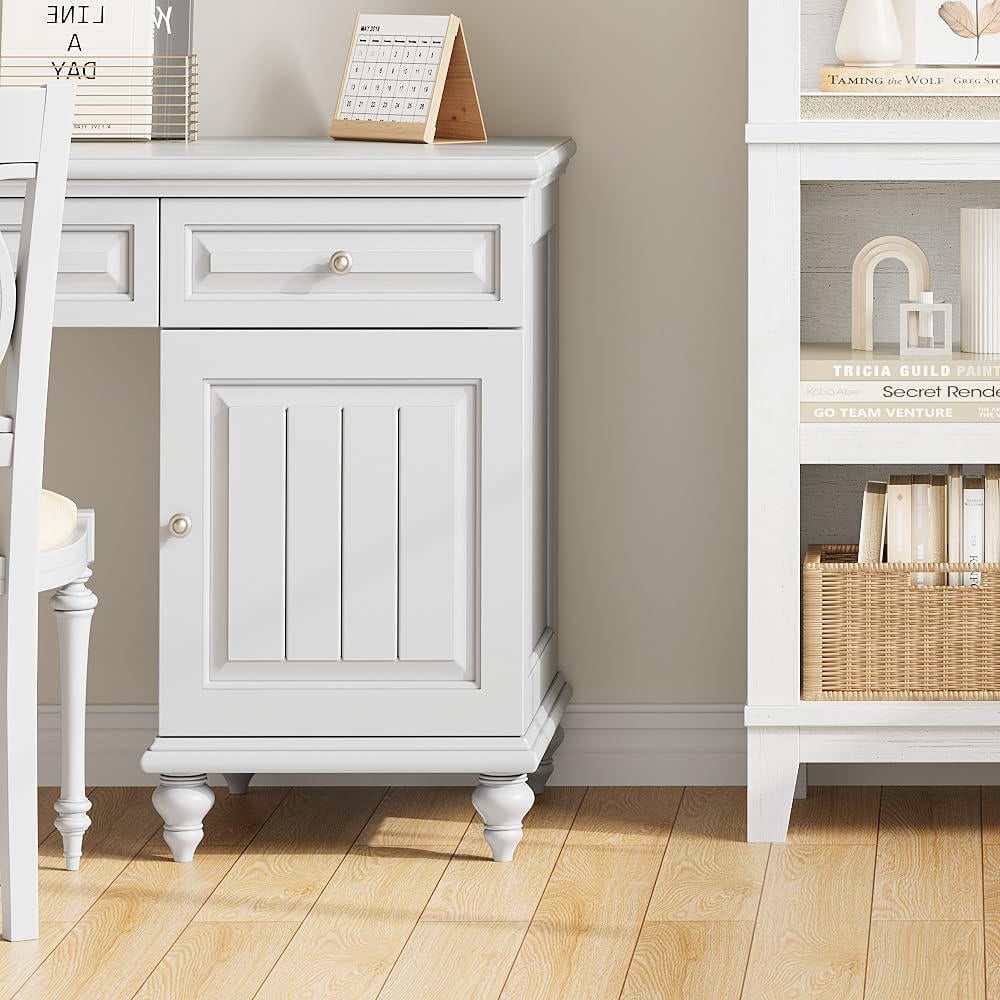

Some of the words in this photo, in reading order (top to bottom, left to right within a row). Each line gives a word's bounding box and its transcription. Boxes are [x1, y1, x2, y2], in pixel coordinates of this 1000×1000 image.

[828, 75, 883, 85] TAMING
[888, 75, 902, 85] the
[905, 75, 944, 85] WOLF
[953, 76, 981, 84] GREG
[833, 366, 891, 376] TRICIA
[900, 366, 950, 376] GUILD
[883, 386, 941, 398] Secret
[814, 408, 835, 417] GO
[844, 408, 880, 417] TEAM
[886, 408, 952, 417] VENTURE
